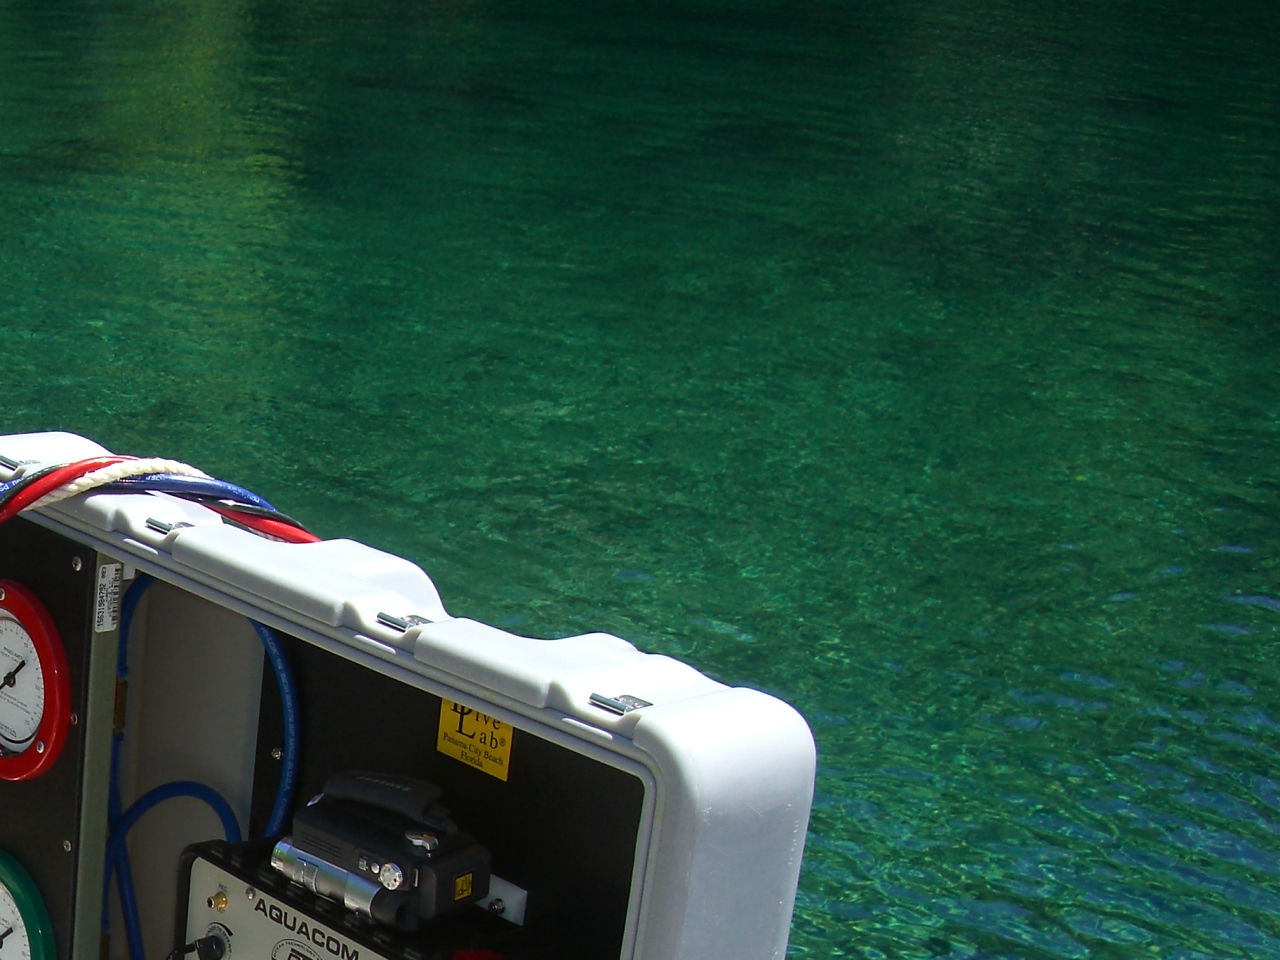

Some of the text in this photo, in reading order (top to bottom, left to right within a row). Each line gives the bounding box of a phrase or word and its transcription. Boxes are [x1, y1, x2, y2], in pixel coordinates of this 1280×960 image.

[443, 731, 504, 766] Panama City Beach
[460, 750, 483, 768] Florida
